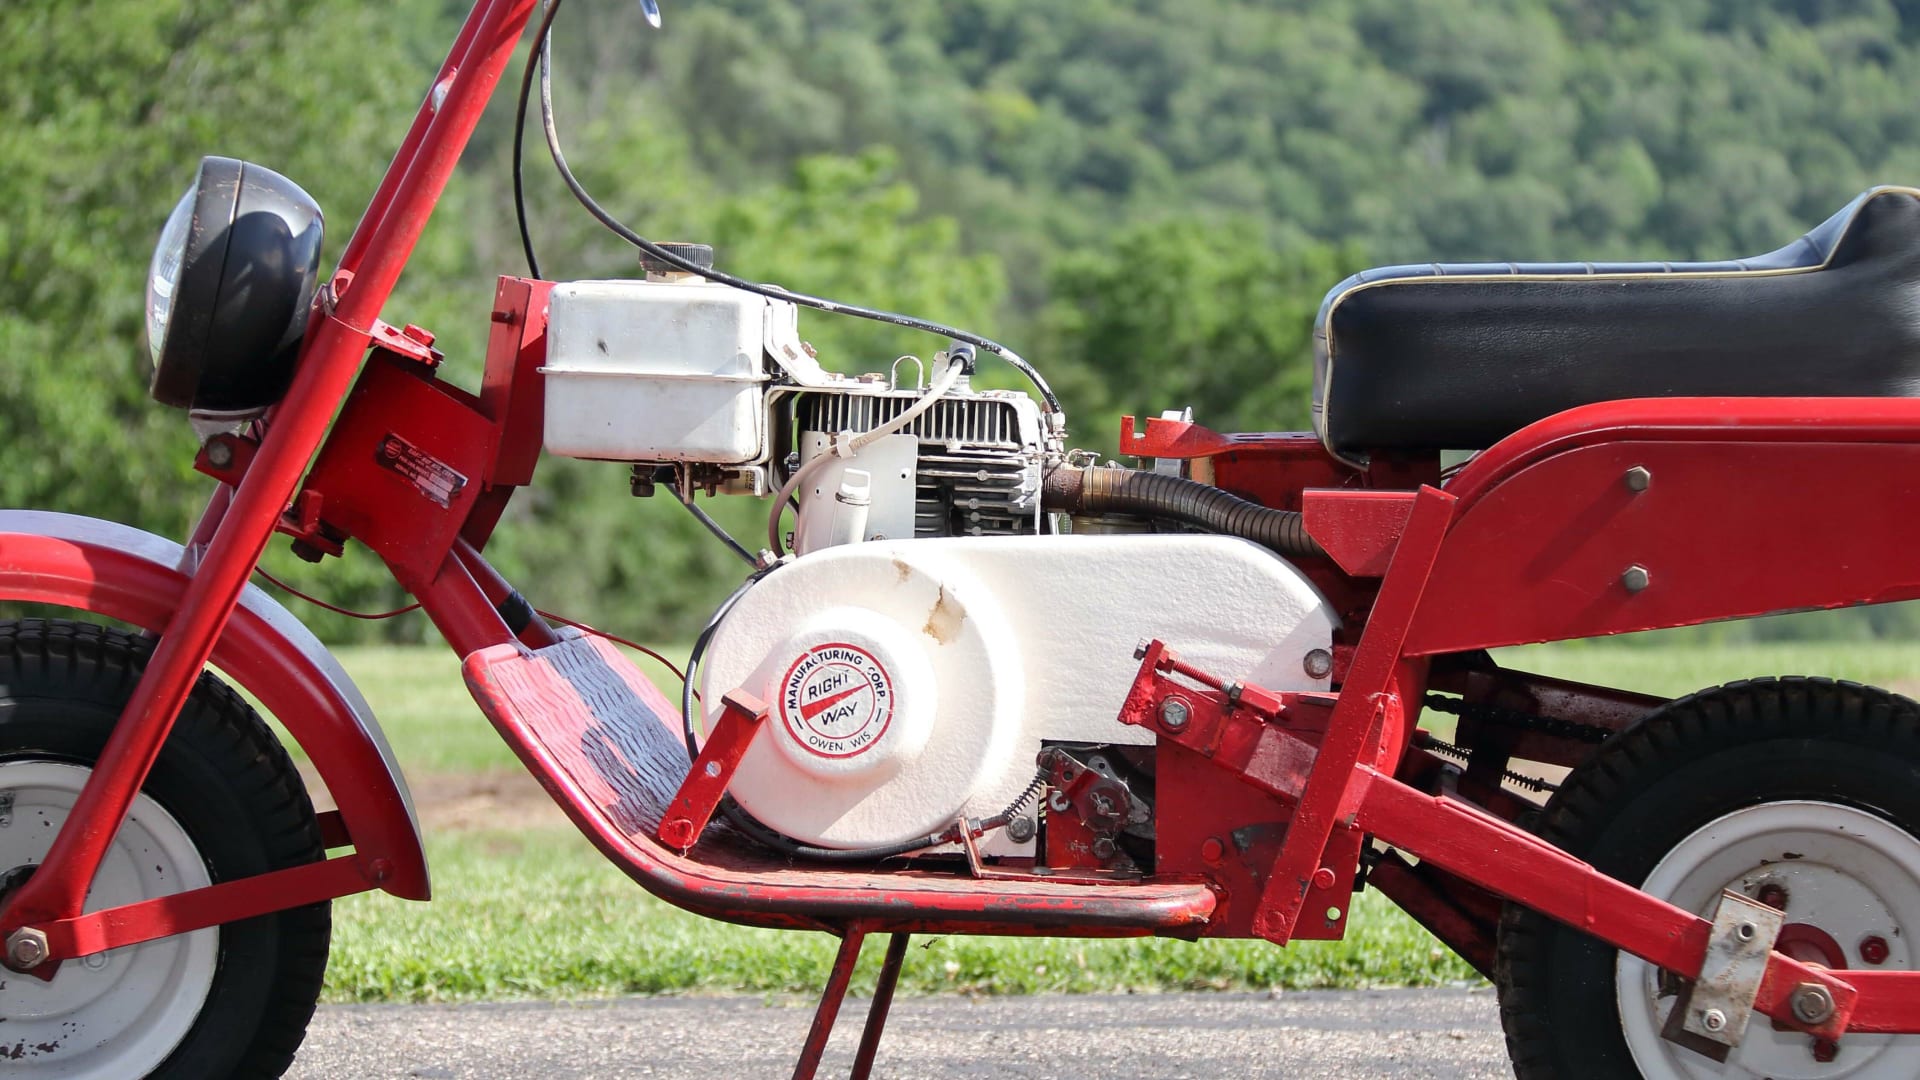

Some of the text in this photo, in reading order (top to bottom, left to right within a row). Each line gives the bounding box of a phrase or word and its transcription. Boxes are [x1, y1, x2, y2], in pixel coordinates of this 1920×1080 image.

[808, 669, 849, 700] RIGHT
[867, 667, 886, 702] CORP.
[821, 701, 858, 725] WAY
[809, 731, 874, 752] OWEN, WIS.
